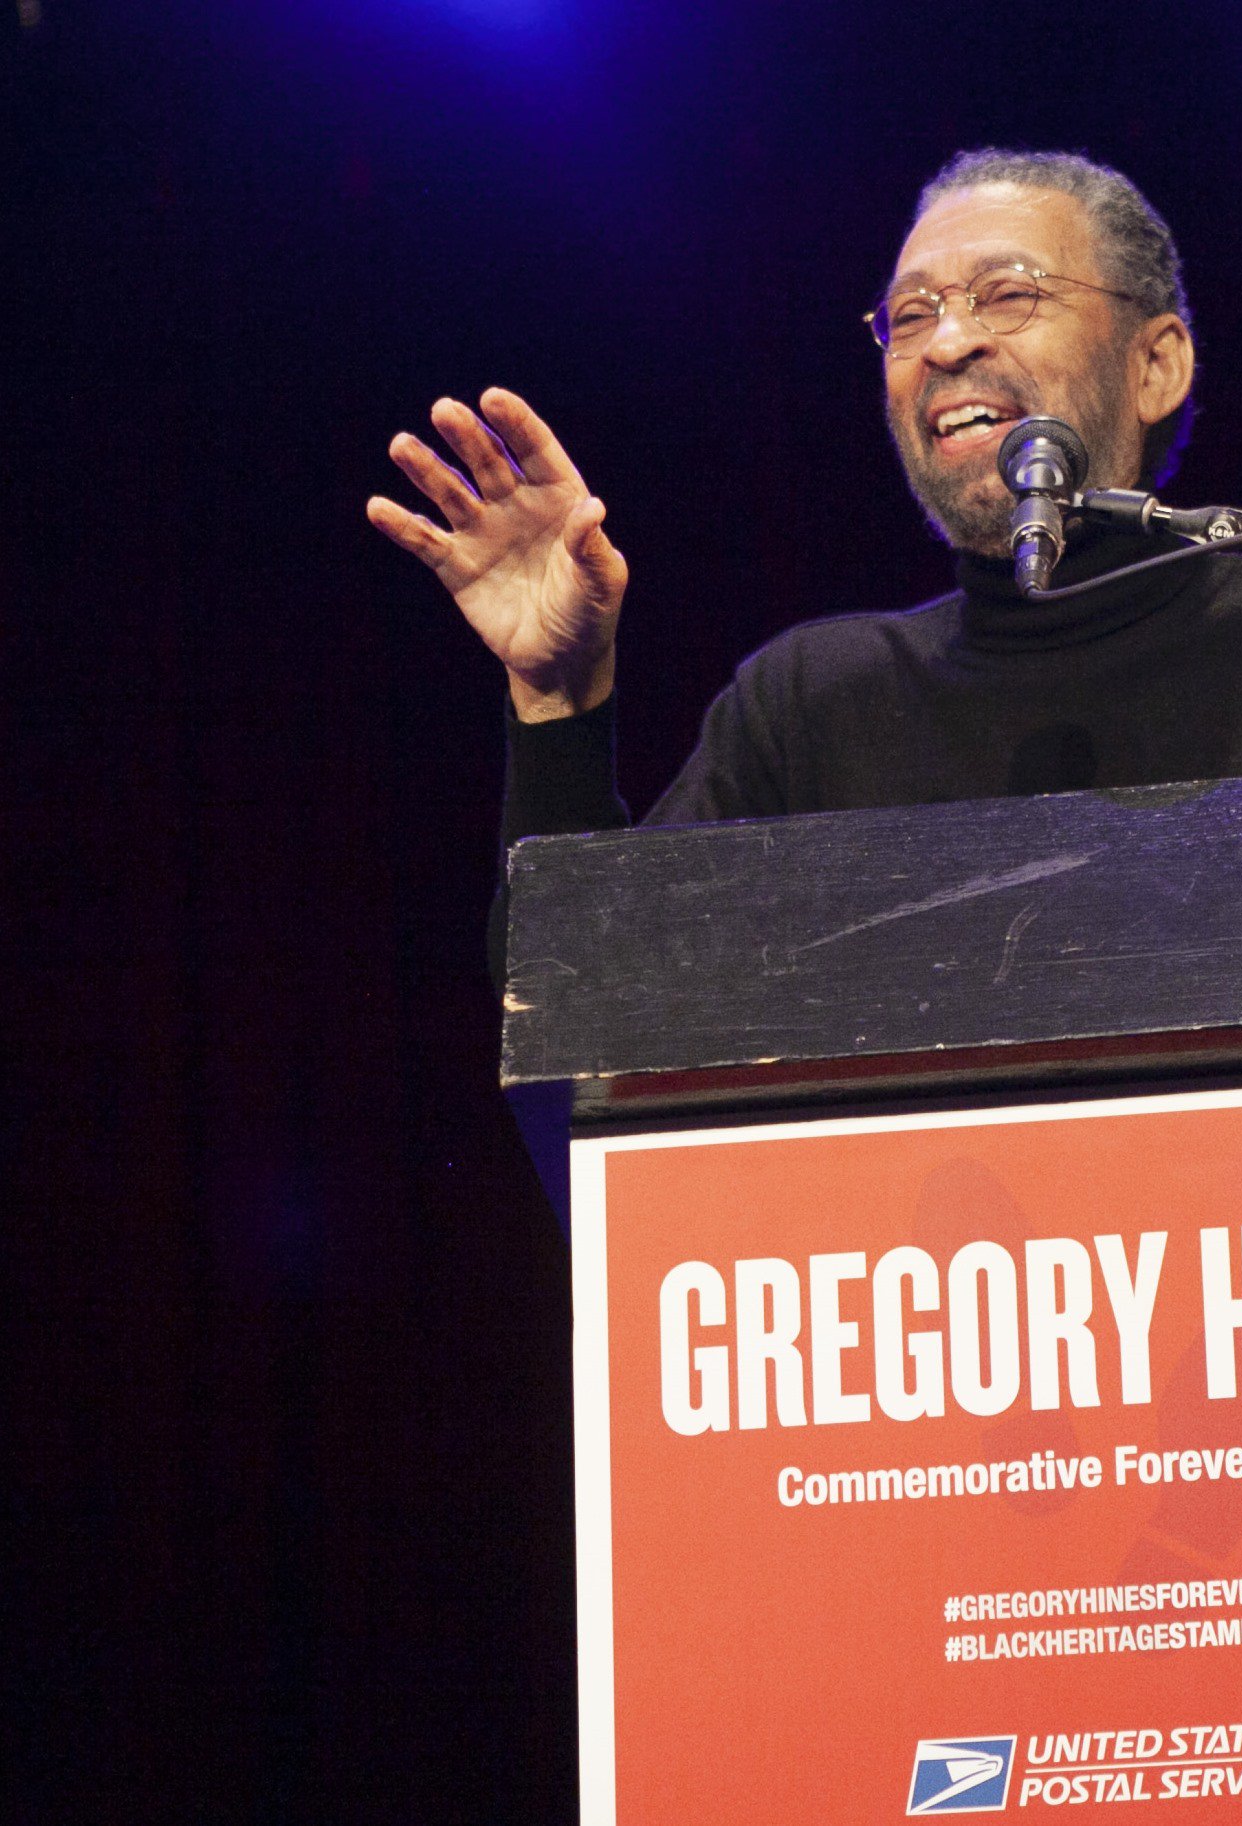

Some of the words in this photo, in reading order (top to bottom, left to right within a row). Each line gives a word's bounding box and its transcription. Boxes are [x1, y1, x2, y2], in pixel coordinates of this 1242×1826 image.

[659, 1230, 1170, 1437] GREGORY
[777, 1448, 1103, 1507] Commemorative
[1027, 1729, 1163, 1765] UNITED
[1019, 1772, 1152, 1807] POSTAL
